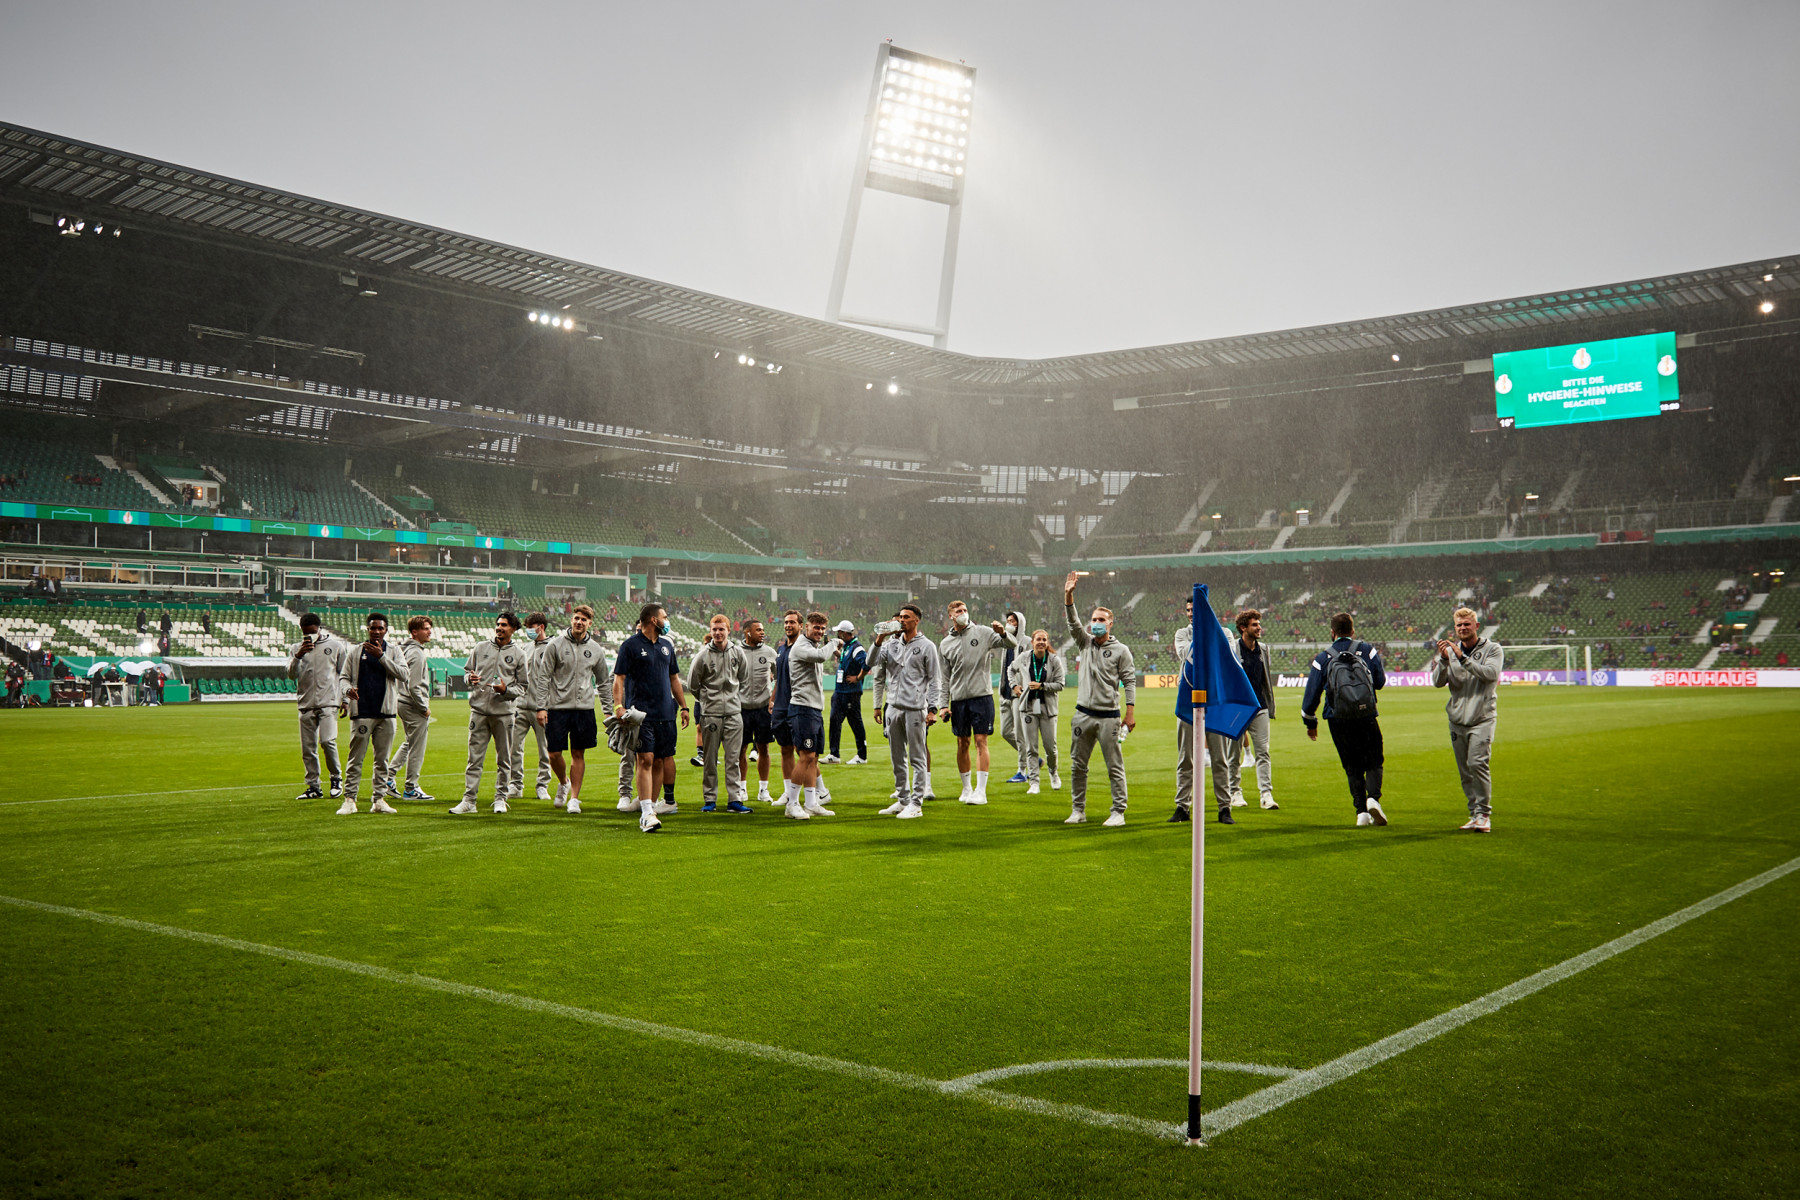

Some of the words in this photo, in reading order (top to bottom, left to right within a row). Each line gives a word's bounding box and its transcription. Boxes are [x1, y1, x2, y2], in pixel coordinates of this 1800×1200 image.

[1562, 378, 1588, 388] BITTE
[1589, 376, 1604, 384] DIE
[1528, 382, 1642, 402] HYGIENE-HINWEISE
[1563, 398, 1606, 409] BEACHTEN
[1665, 672, 1757, 686] BAUHAUS
